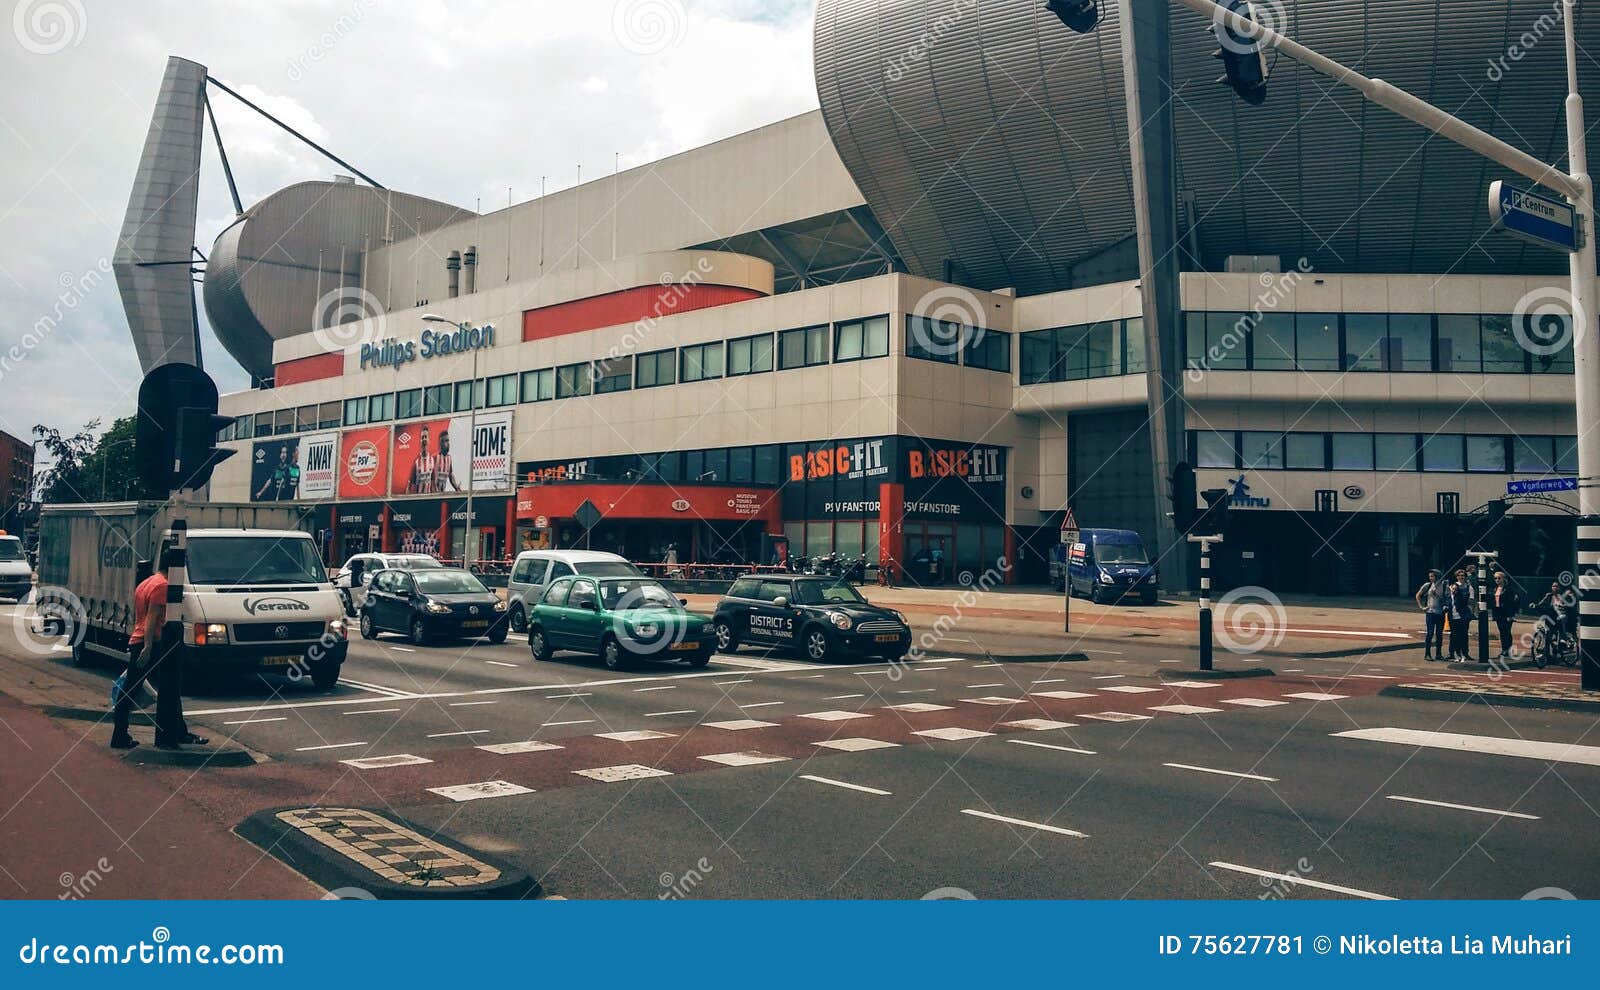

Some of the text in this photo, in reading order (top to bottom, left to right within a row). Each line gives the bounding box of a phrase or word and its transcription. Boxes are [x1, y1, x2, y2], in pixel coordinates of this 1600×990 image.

[360, 321, 496, 371] Philips Stadion
[473, 426, 506, 458] HOME
[306, 444, 333, 471] AWAY
[357, 456, 369, 466] PSV
[790, 440, 883, 481] BASIC-FIT
[909, 449, 998, 478] BASIC-FIT
[1522, 481, 1562, 490] Vonderweg
[825, 501, 881, 512] PSV FANSTOR
[919, 502, 961, 514] FANSTORE
[452, 511, 476, 521] FANSTRE
[243, 597, 310, 616] Verano
[750, 614, 784, 628] DISTRICT
[750, 627, 793, 638] PERSONAL TRAINING
